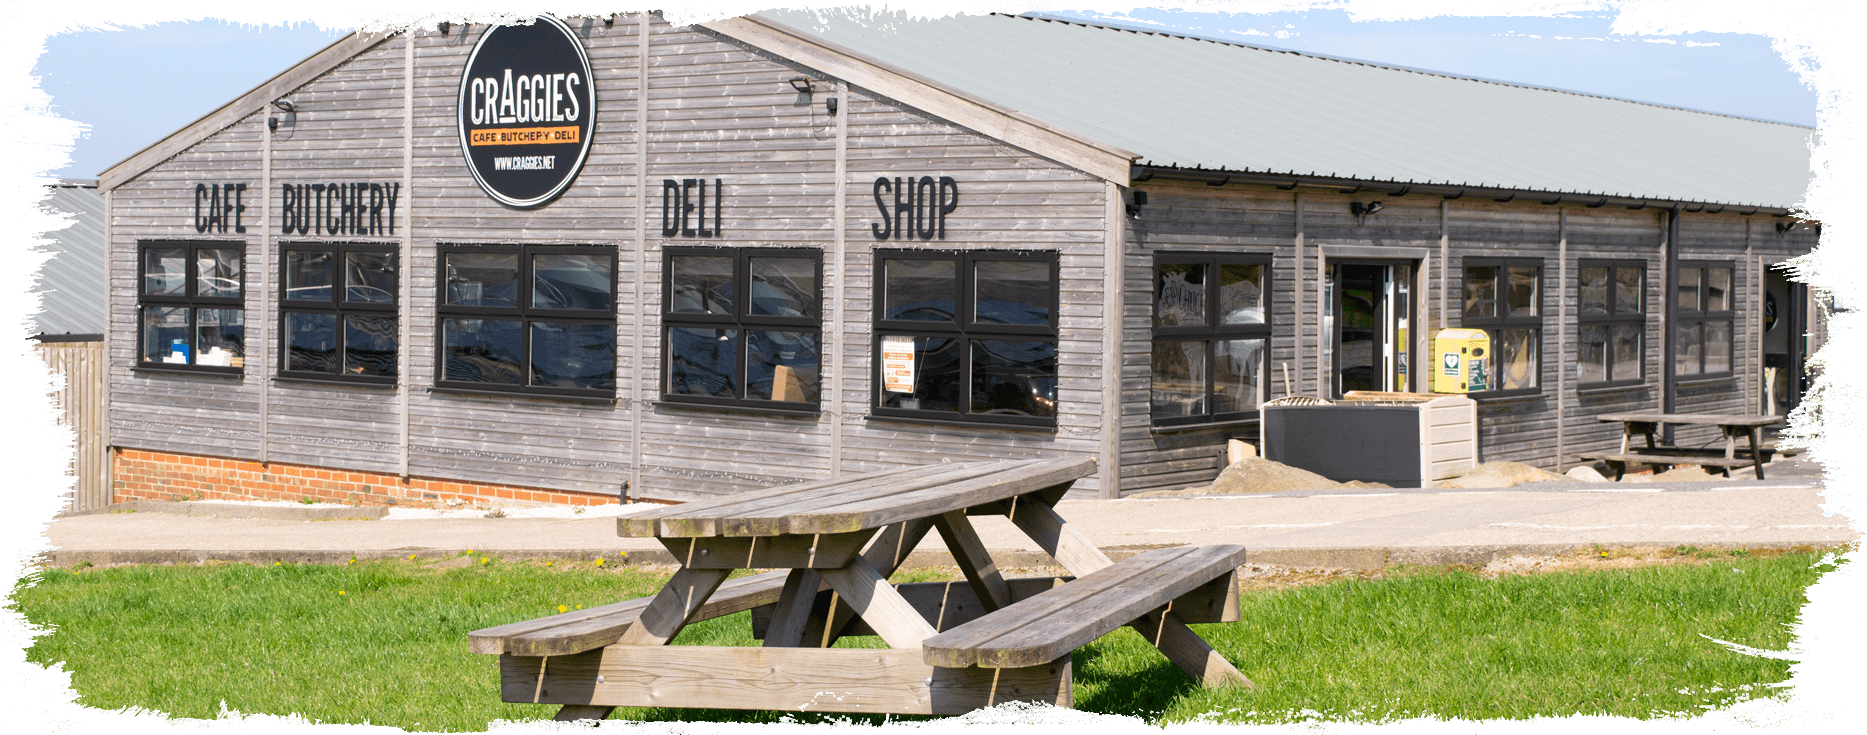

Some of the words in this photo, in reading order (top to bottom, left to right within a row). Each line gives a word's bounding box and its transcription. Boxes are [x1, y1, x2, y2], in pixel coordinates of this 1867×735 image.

[471, 69, 580, 125] CRAGGIES
[473, 133, 497, 142] CAFE
[501, 131, 550, 142] BUTCHERY
[554, 130, 576, 141] DELI
[494, 155, 556, 171] WWW.CRAGGIES.NET
[194, 182, 247, 234] CAFE
[281, 182, 400, 235] BUTCHERY
[661, 178, 722, 237] DELI
[871, 175, 958, 240] SHOP
